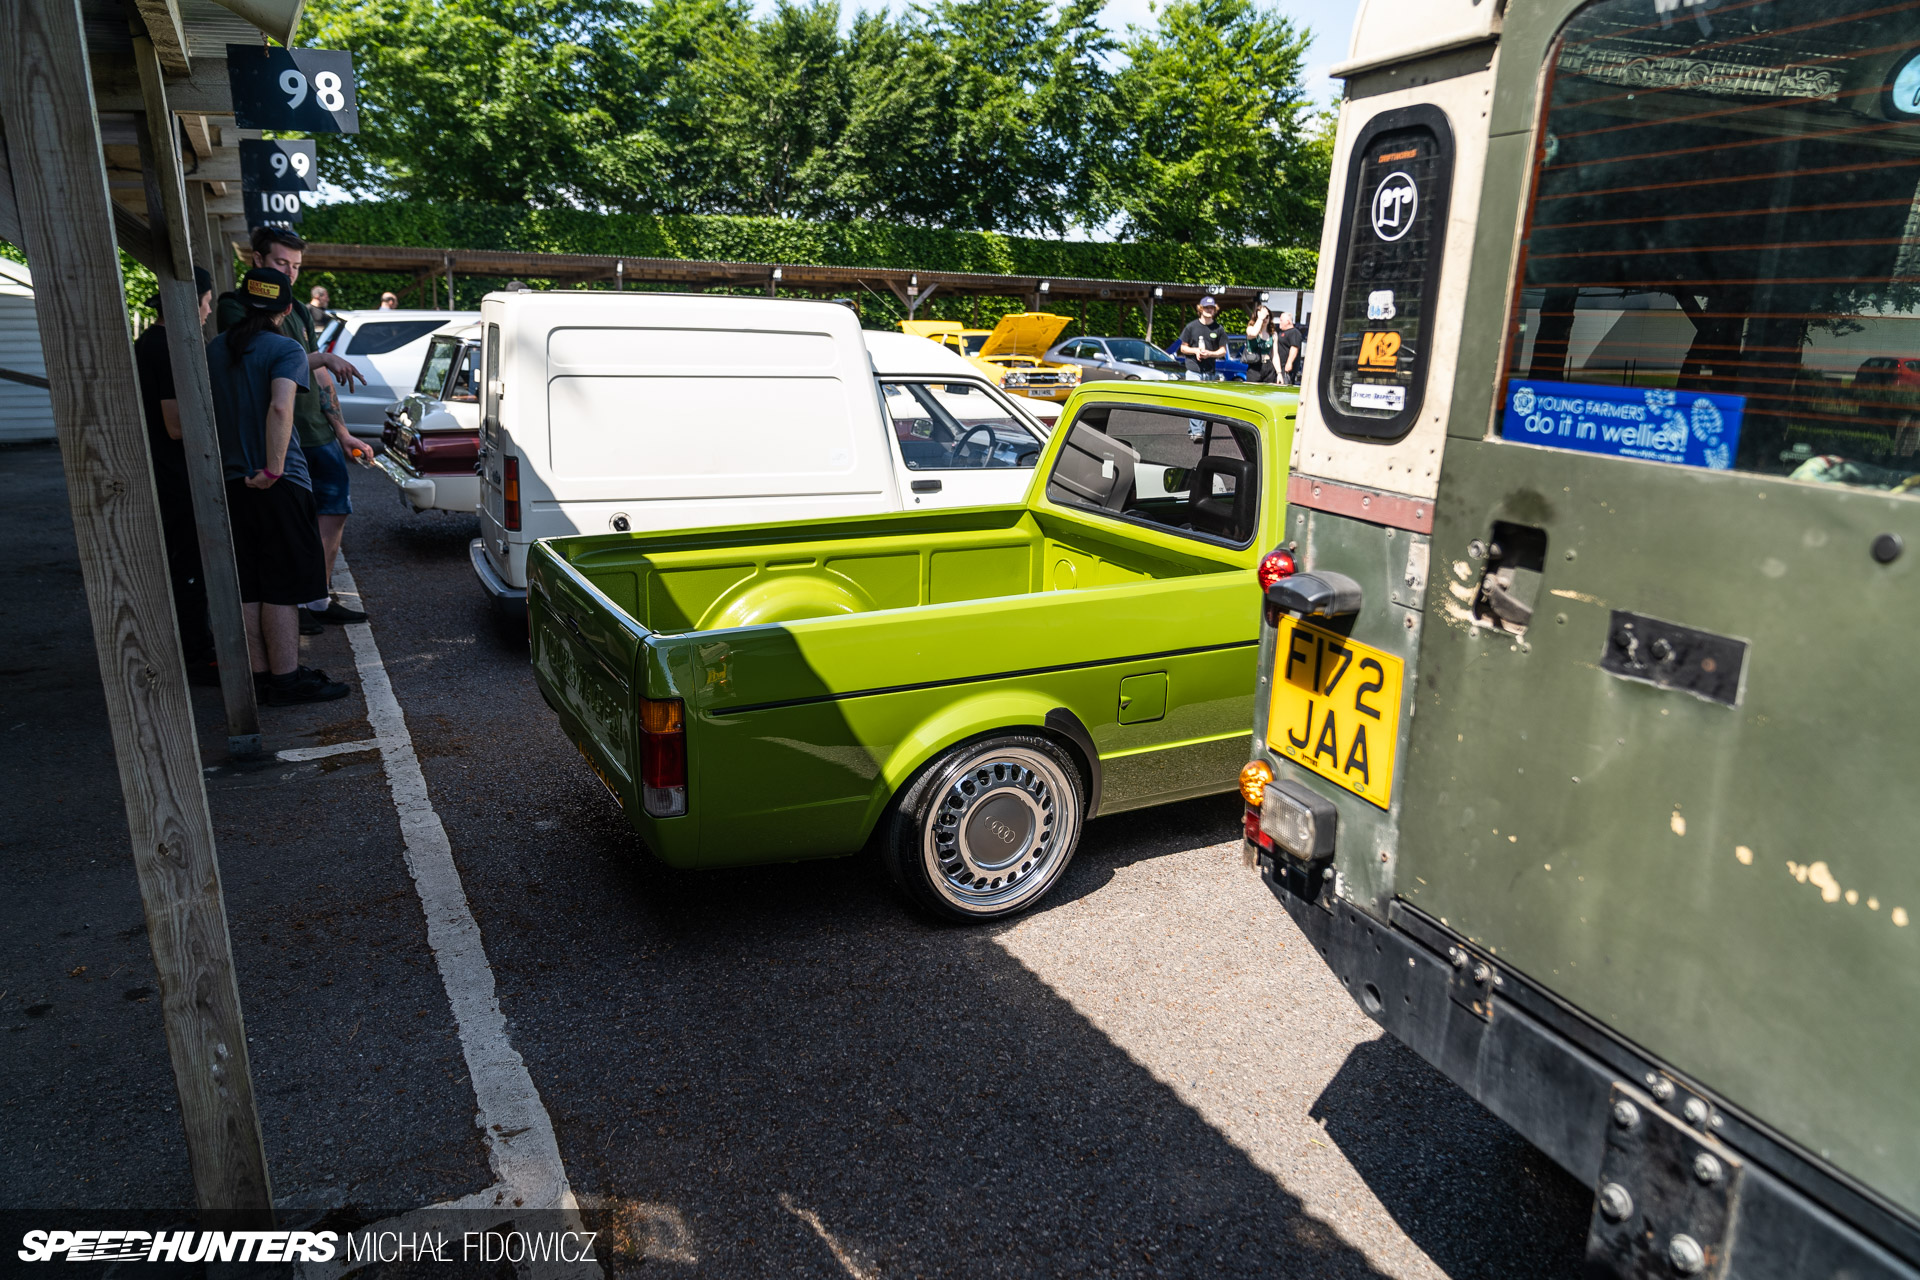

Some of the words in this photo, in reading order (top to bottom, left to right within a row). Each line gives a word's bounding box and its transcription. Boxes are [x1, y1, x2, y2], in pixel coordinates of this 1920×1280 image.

[279, 69, 345, 112] 98
[270, 152, 310, 178] 99
[261, 193, 300, 213] 100
[1357, 331, 1402, 366] K2
[1537, 396, 1584, 414] YOUNG
[1585, 400, 1647, 421] FARMERS
[1524, 412, 1554, 435] do
[1558, 413, 1573, 437] it
[1576, 415, 1597, 440] in
[1601, 422, 1689, 453] wellies!
[1285, 627, 1385, 720] F172
[1288, 700, 1370, 786] JAA
